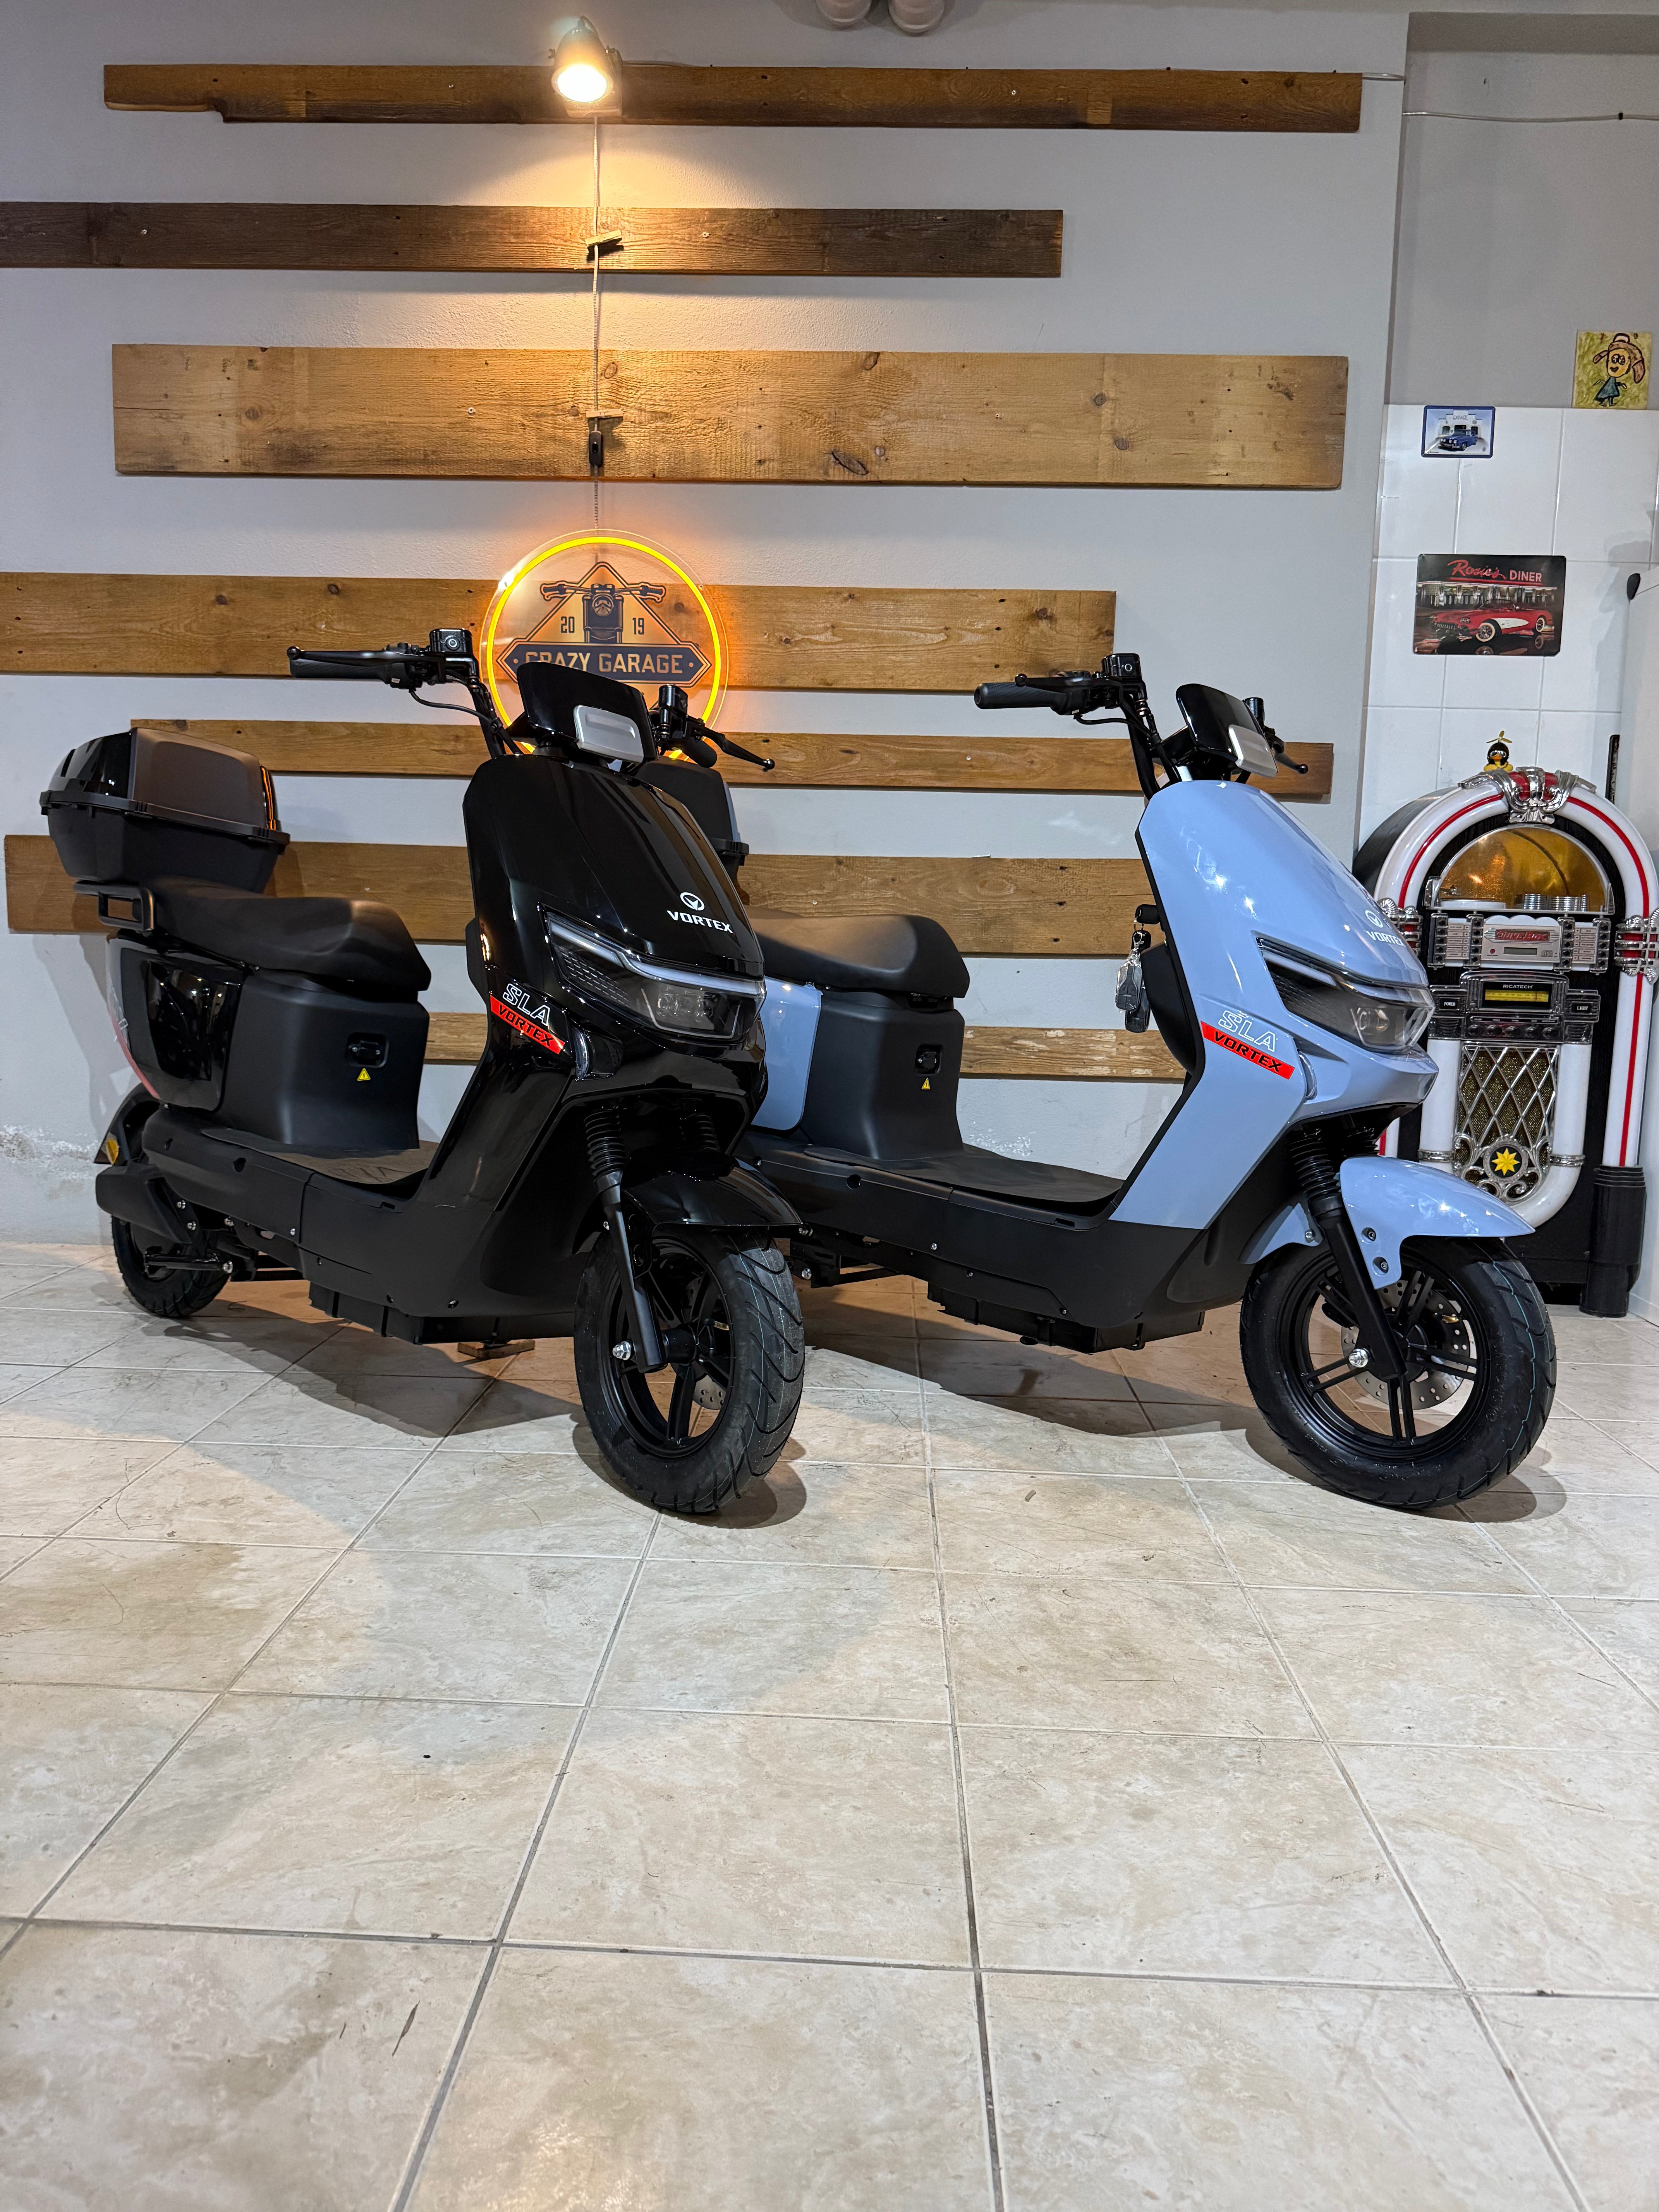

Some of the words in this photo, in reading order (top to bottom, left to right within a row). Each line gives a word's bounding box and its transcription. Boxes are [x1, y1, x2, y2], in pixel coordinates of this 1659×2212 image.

[1510, 570, 1542, 582] DINER
[560, 616, 575, 634] 20
[632, 617, 645, 635] 19
[599, 653, 683, 674] GARAGE
[666, 910, 734, 934] VORTEX
[1366, 931, 1407, 948] VORTEX
[502, 983, 550, 1026] SLA
[498, 1004, 554, 1047] VORTEX
[1218, 1010, 1276, 1053] SLA
[1214, 1031, 1283, 1073] VORTEX
